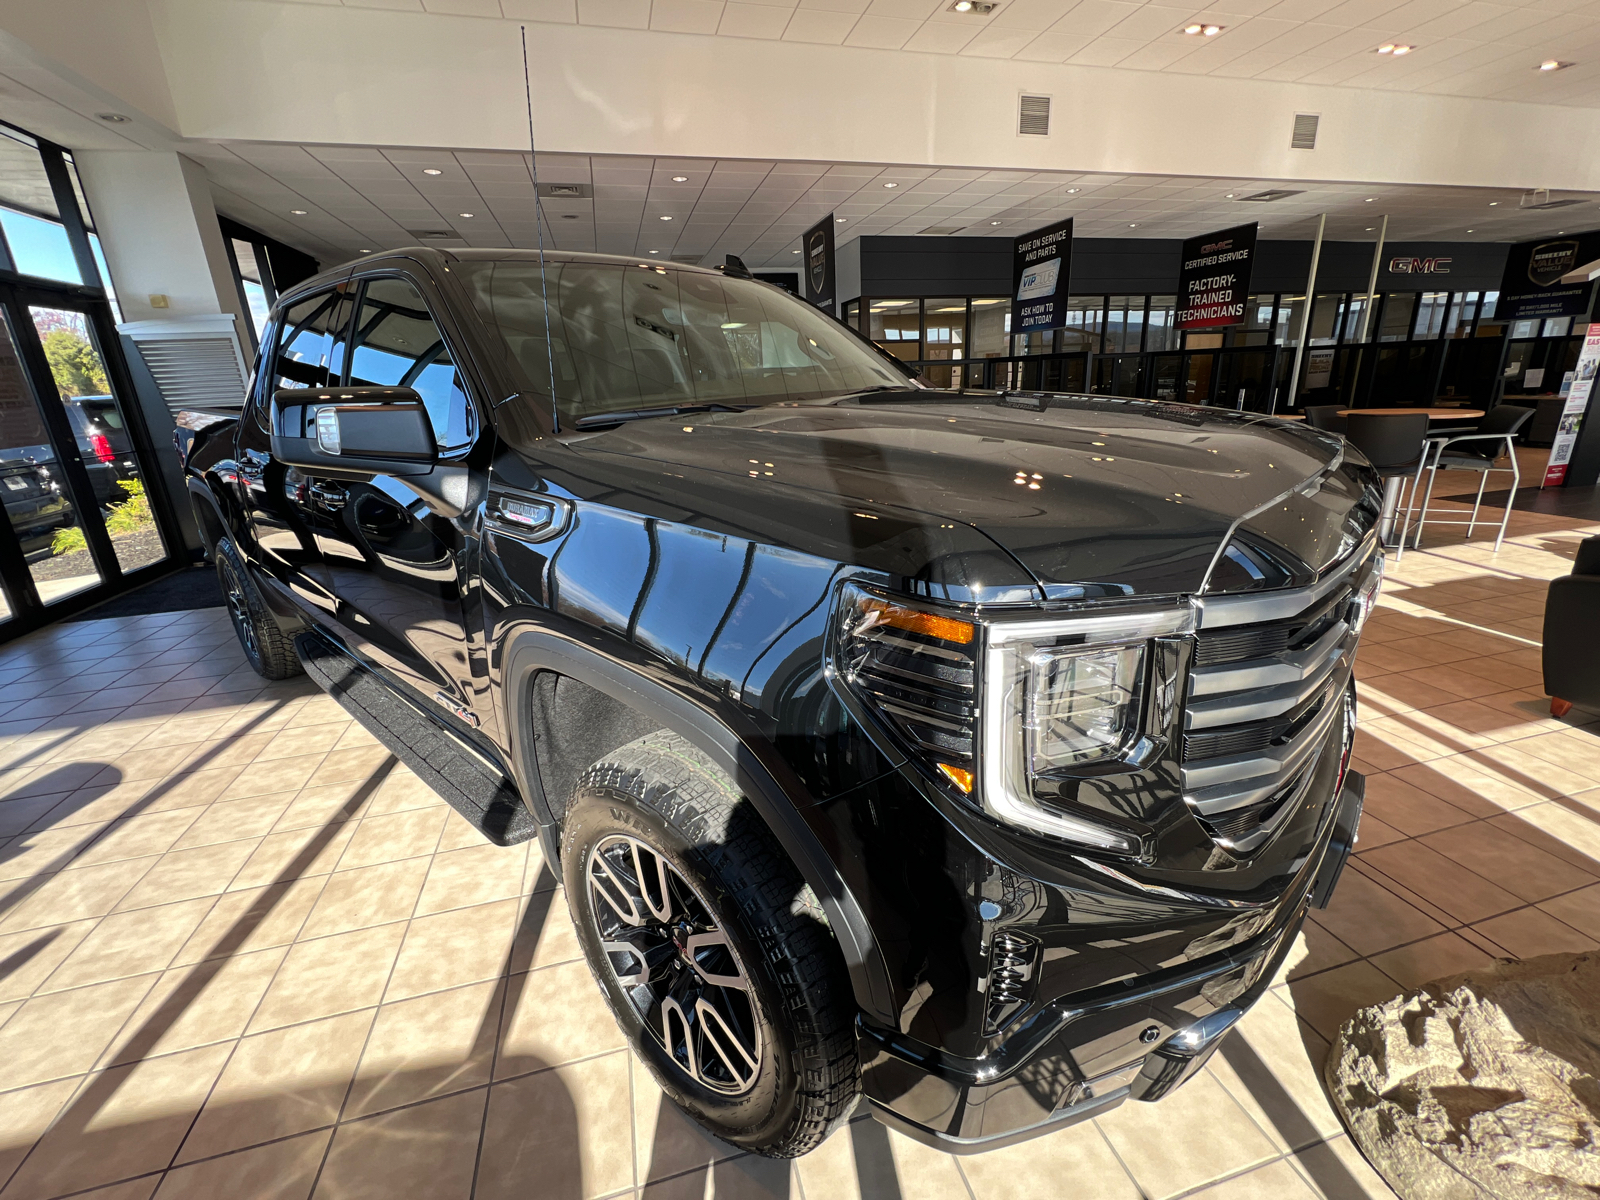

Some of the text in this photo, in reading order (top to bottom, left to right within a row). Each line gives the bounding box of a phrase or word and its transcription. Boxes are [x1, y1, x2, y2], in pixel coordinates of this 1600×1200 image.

[1018, 229, 1067, 254] SAVE ON SERVICE
[1200, 239, 1234, 255] GMC
[1025, 244, 1057, 262] AND PARTS
[1184, 249, 1249, 270] CERTIFIED SERVICE
[1389, 257, 1453, 274] GMC
[1532, 256, 1573, 268] VALUE
[1023, 276, 1037, 288] VIP
[1188, 274, 1237, 293] FACTORY-
[1188, 289, 1233, 307] TRAINED
[1020, 302, 1054, 317] ASK HOW TO
[1177, 303, 1244, 322] TECHNICIANS
[1021, 313, 1053, 327] JOIN TODAY
